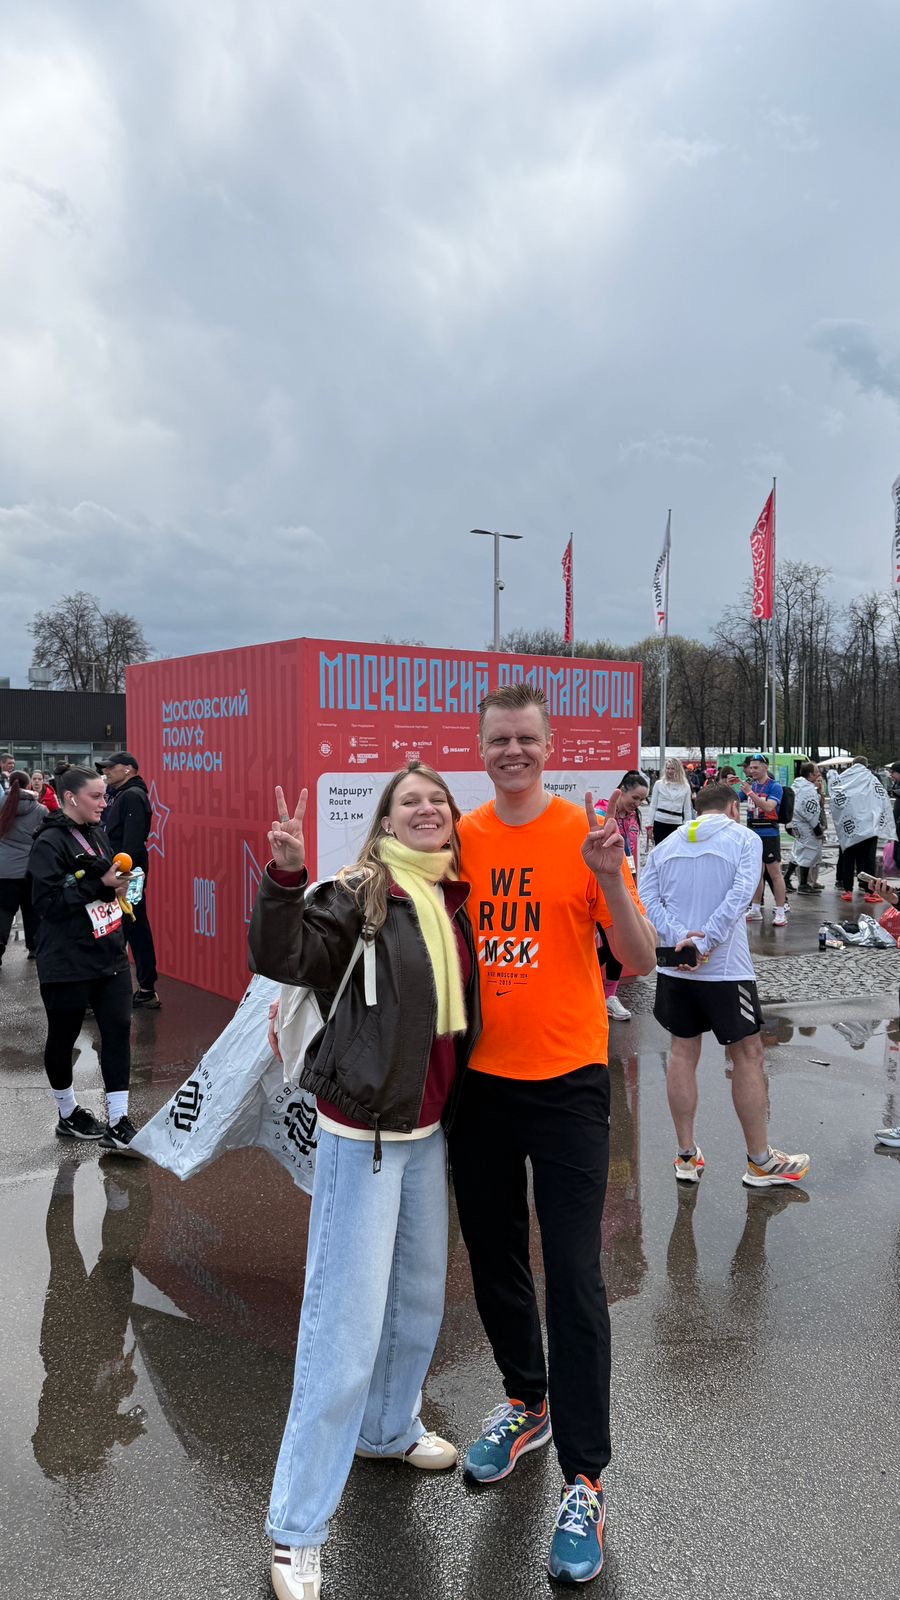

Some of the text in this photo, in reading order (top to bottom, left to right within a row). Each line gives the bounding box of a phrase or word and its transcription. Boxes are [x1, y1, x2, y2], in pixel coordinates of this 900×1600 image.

[319, 650, 488, 714] МОСКОВСКИЙ
[162, 687, 248, 722] МОСКОВСКИЙ
[163, 726, 195, 747] ПОЛУ
[163, 751, 223, 772] МАРАФОН
[329, 786, 373, 797] Маршрут
[544, 783, 577, 792] Маршрут
[329, 798, 352, 806] Route
[330, 811, 348, 822] 21,1
[491, 867, 534, 897] WE
[193, 876, 216, 937] 2026
[478, 900, 541, 932] RUN
[484, 939, 532, 964] MSK
